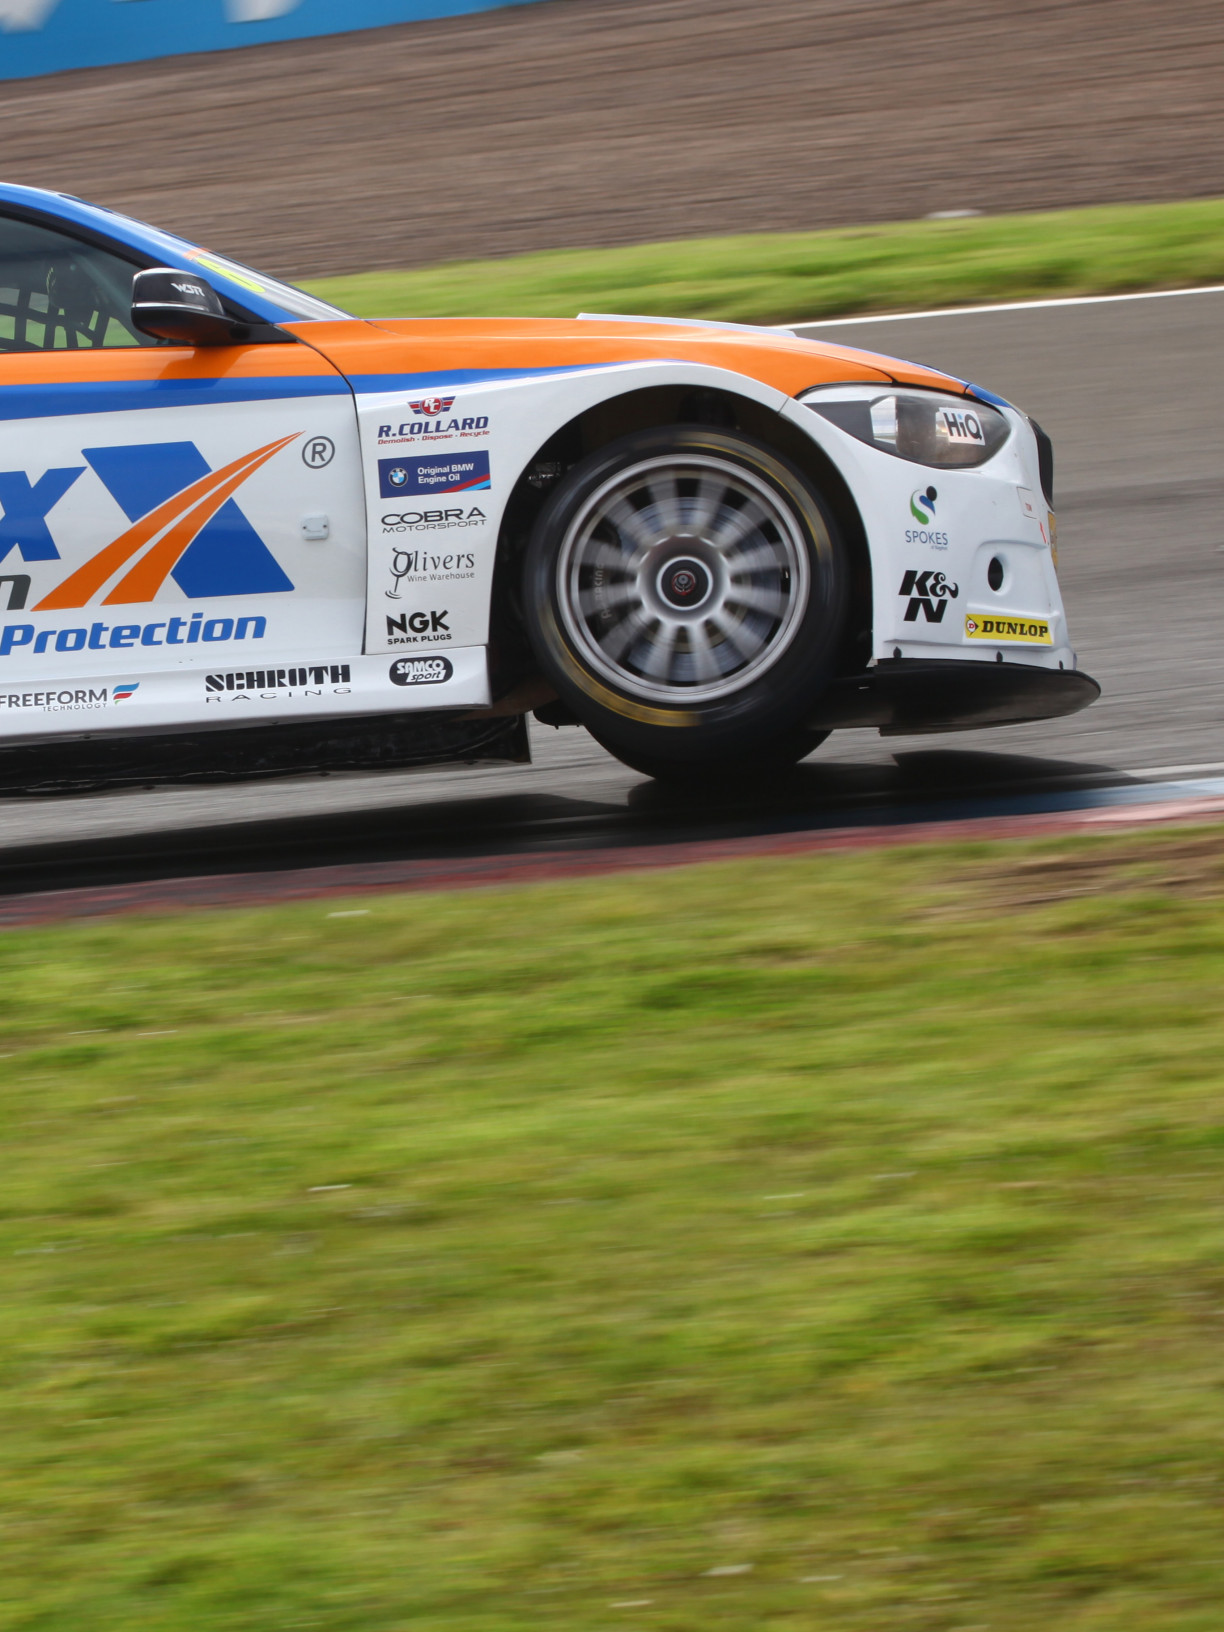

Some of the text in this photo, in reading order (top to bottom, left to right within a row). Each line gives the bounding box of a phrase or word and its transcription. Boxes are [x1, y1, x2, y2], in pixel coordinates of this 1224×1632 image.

[378, 416, 489, 438] R.COLLARD
[943, 412, 982, 440] HiQ
[377, 429, 490, 445] Demolish Dispose Recycle
[417, 465, 450, 476] Original
[451, 463, 474, 472] BMW
[418, 473, 460, 485] Engine Oil
[381, 506, 486, 526] COBRA
[382, 519, 487, 534] MOTORSPORT
[904, 530, 948, 546] SPOKES
[390, 547, 475, 577] Olivers
[407, 571, 475, 583] Wine Warehouse
[386, 609, 451, 636] NGK
[981, 620, 1048, 637] DUNLOP
[387, 633, 452, 645] SPARK PLUGS
[396, 659, 445, 675] SAMCO
[205, 664, 351, 692] SCHROTH
[410, 670, 442, 682] sport
[206, 687, 352, 704] RACING
[42, 702, 108, 713] TECHNOLOGY
